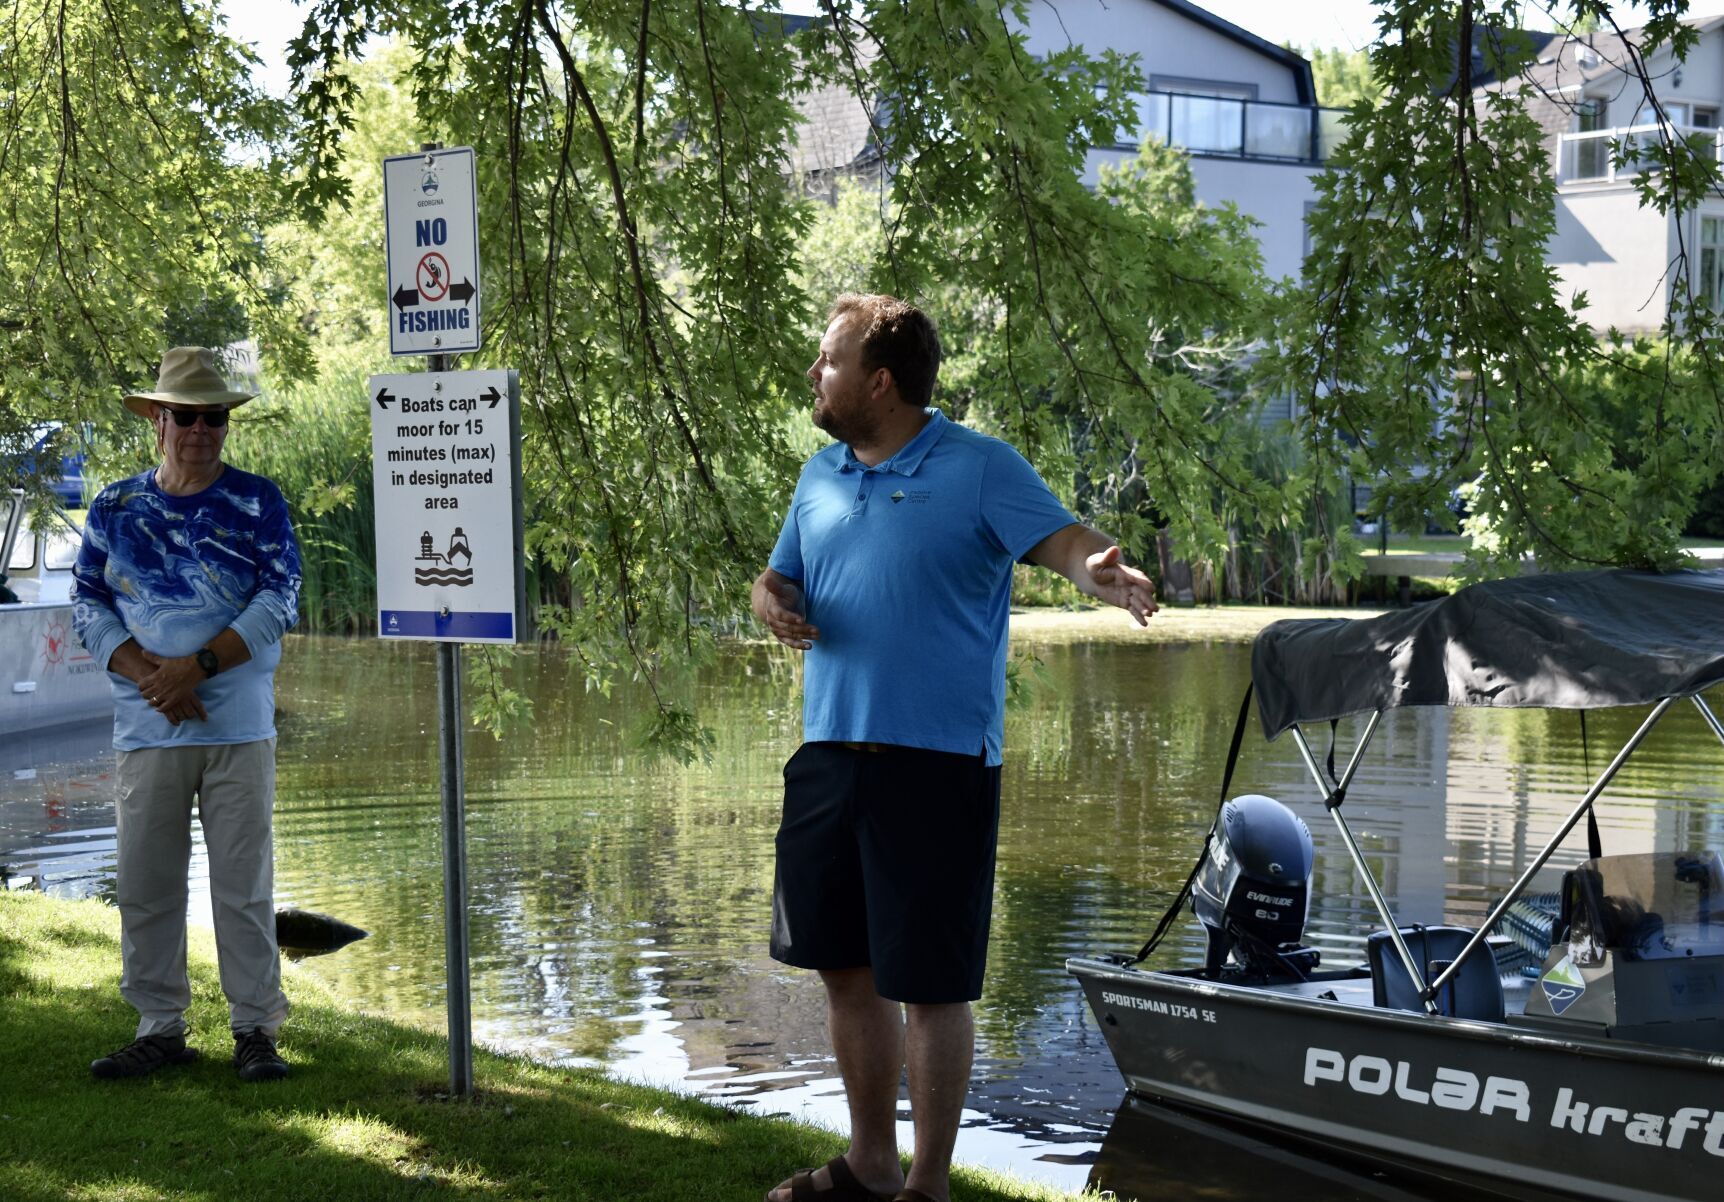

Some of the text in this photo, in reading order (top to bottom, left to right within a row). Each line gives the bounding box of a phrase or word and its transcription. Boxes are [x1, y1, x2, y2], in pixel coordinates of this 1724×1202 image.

[417, 199, 444, 207] GEORGINA
[415, 217, 447, 247] NO
[399, 307, 470, 333] FISHING
[401, 397, 477, 413] Boats can
[397, 419, 483, 437] moor for 15
[387, 443, 495, 464] minutes (max)
[391, 468, 493, 489] in designated
[425, 496, 458, 510] area
[1246, 892, 1293, 906] EVINRUDE
[1102, 991, 1217, 1023] SPORTSMAN 1754 SE
[1303, 1047, 1724, 1157] POLAR kraft
